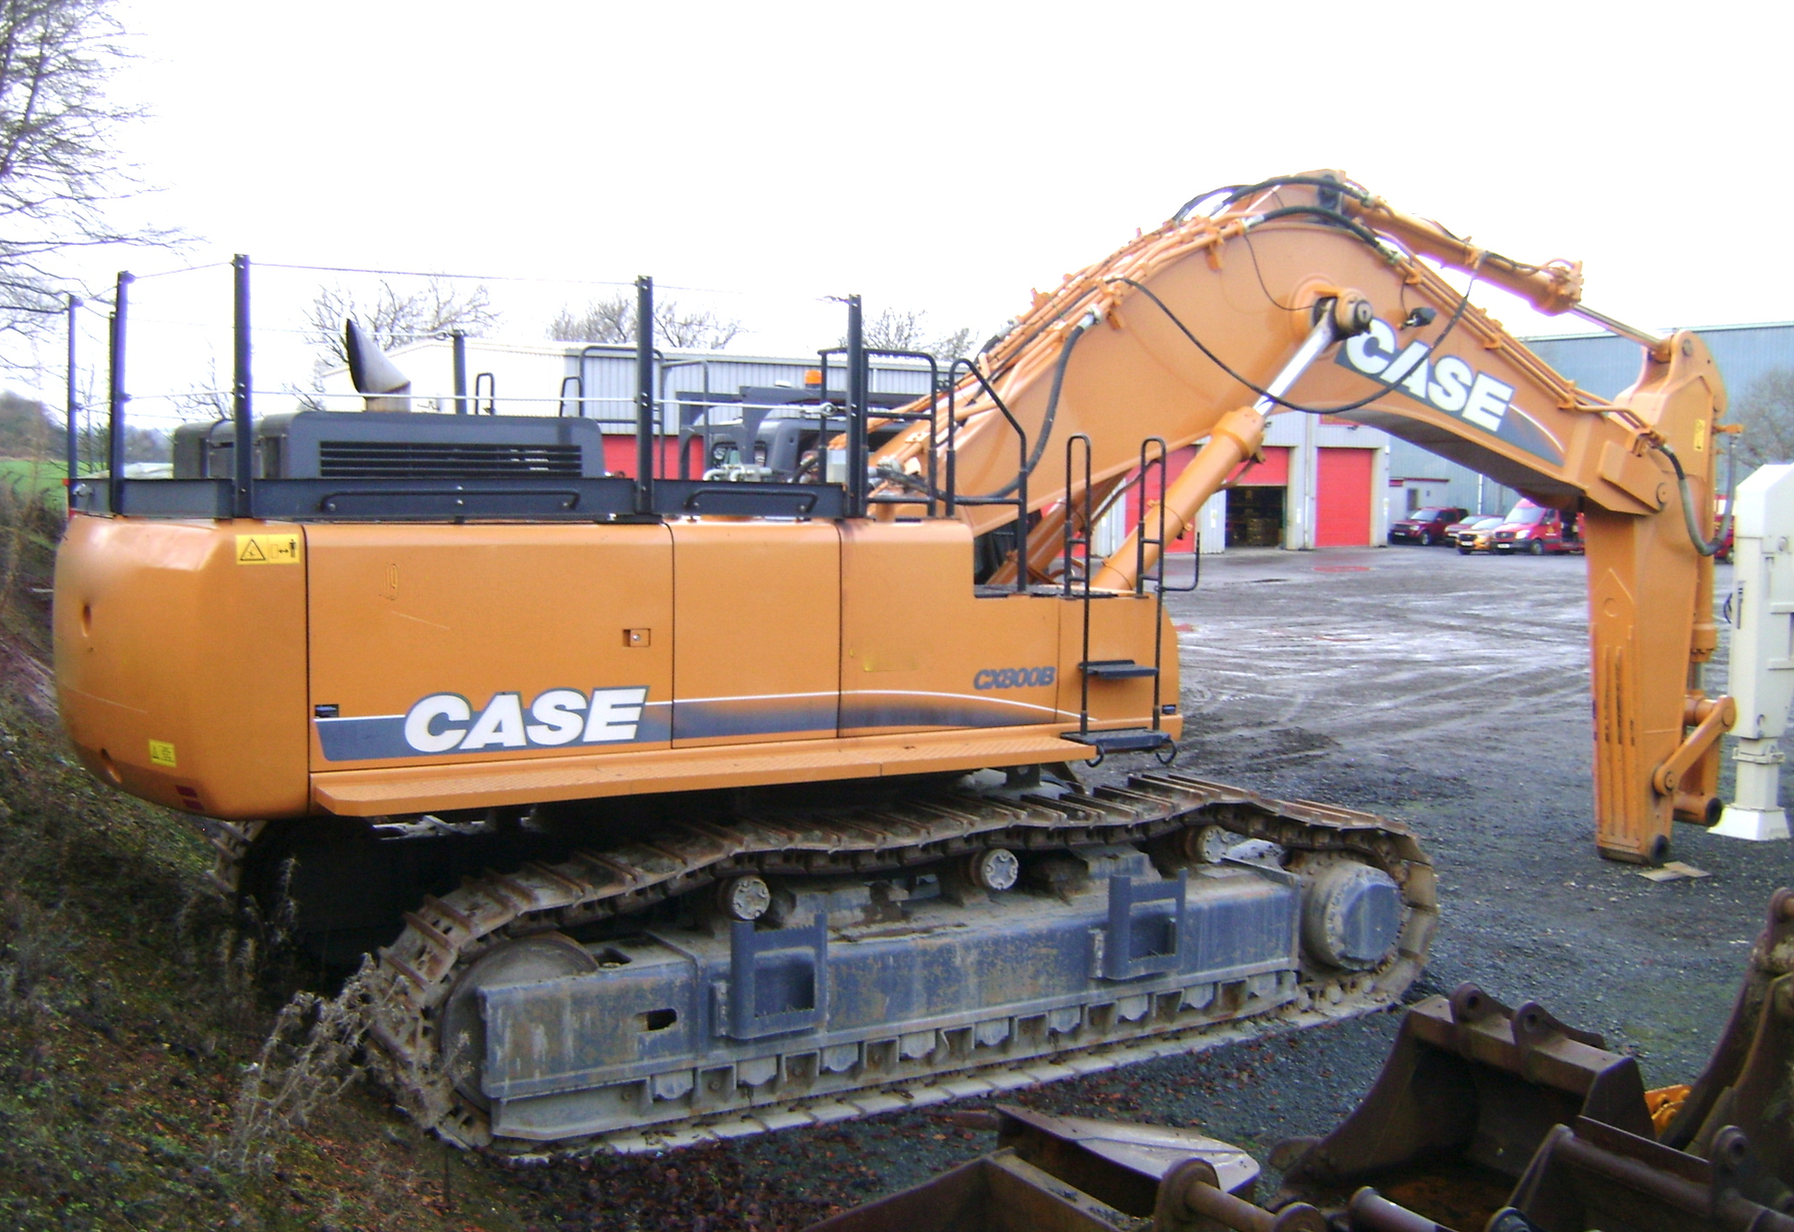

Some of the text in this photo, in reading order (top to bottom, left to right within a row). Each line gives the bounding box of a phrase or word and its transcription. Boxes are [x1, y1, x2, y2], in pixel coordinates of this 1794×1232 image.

[1346, 318, 1515, 432] CASE
[973, 666, 1056, 690] CX800B
[404, 687, 648, 752] CASE
